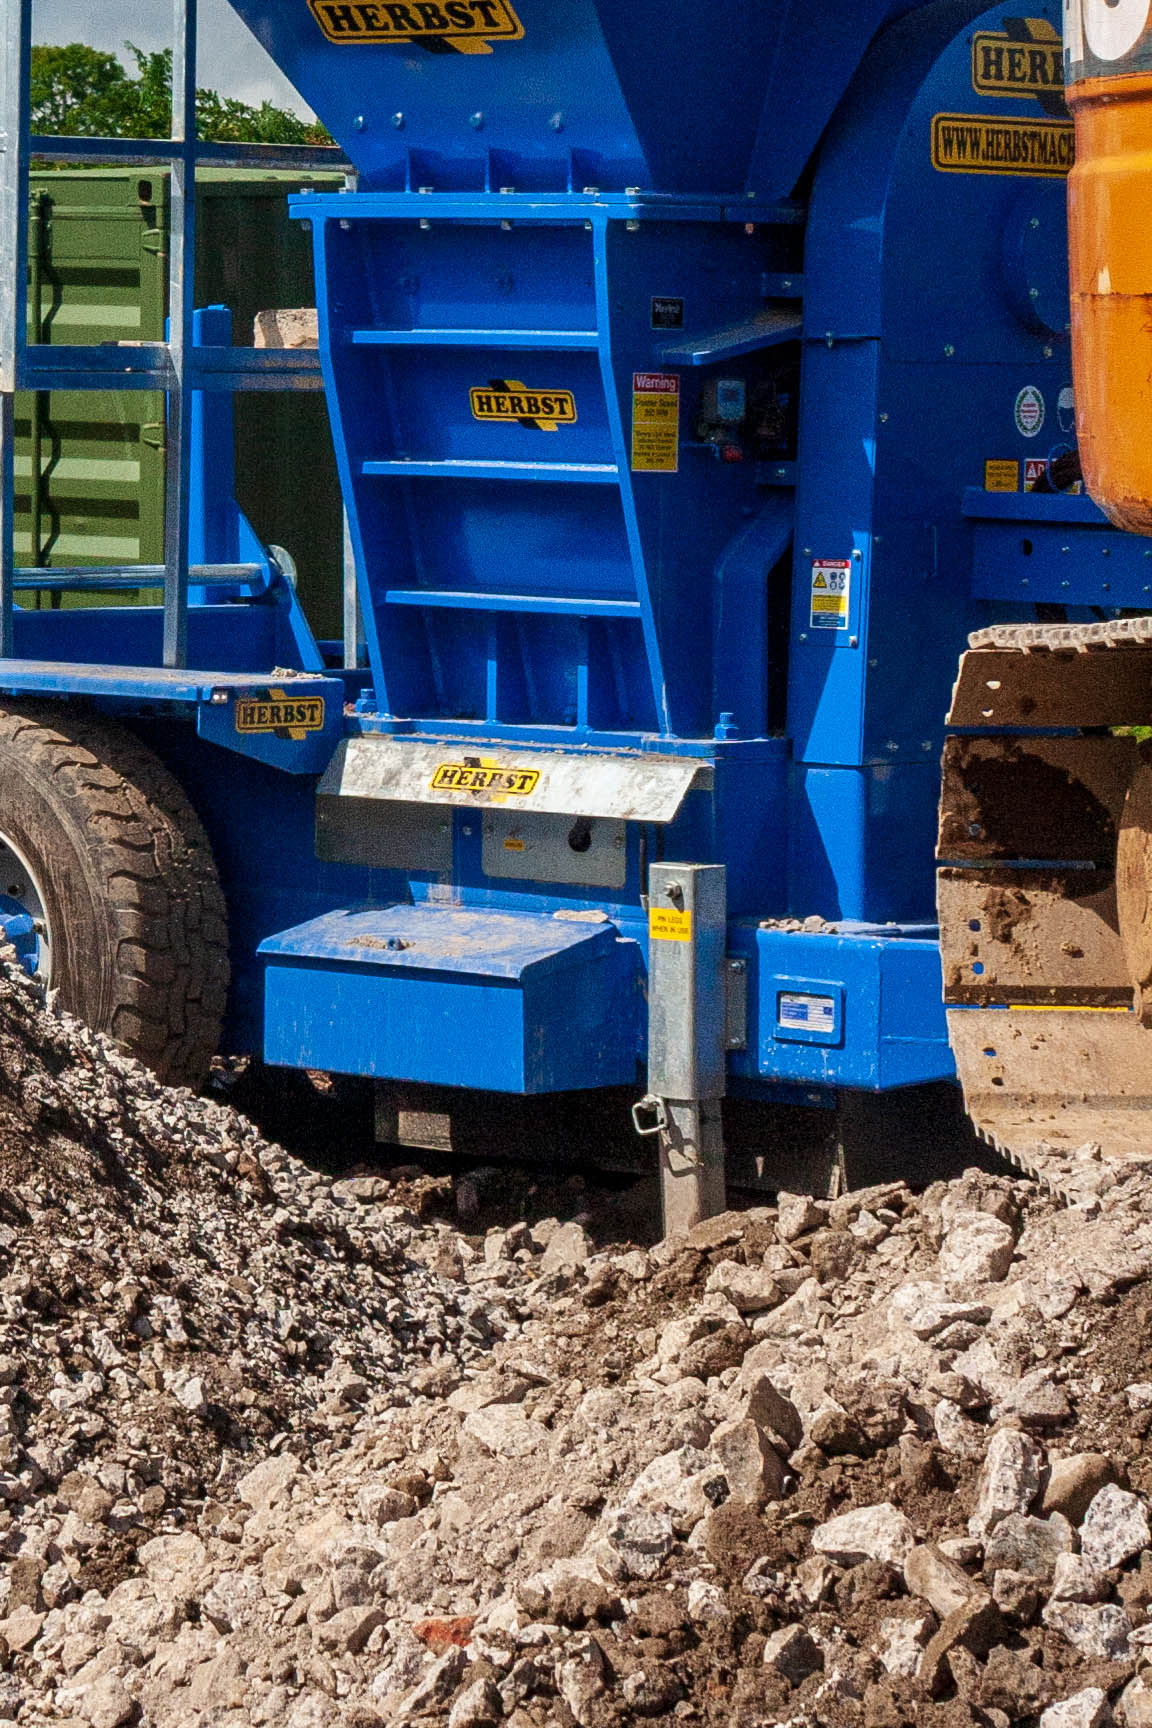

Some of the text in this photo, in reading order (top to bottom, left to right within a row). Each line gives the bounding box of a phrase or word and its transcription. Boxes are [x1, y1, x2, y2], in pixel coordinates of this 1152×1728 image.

[321, 0, 498, 33] HERBST
[981, 46, 1064, 85] HERB
[941, 125, 1076, 165] WWW.HERBSTMACH
[636, 375, 676, 392] Warning
[476, 395, 569, 415] HERBST
[242, 704, 319, 725] HERBST
